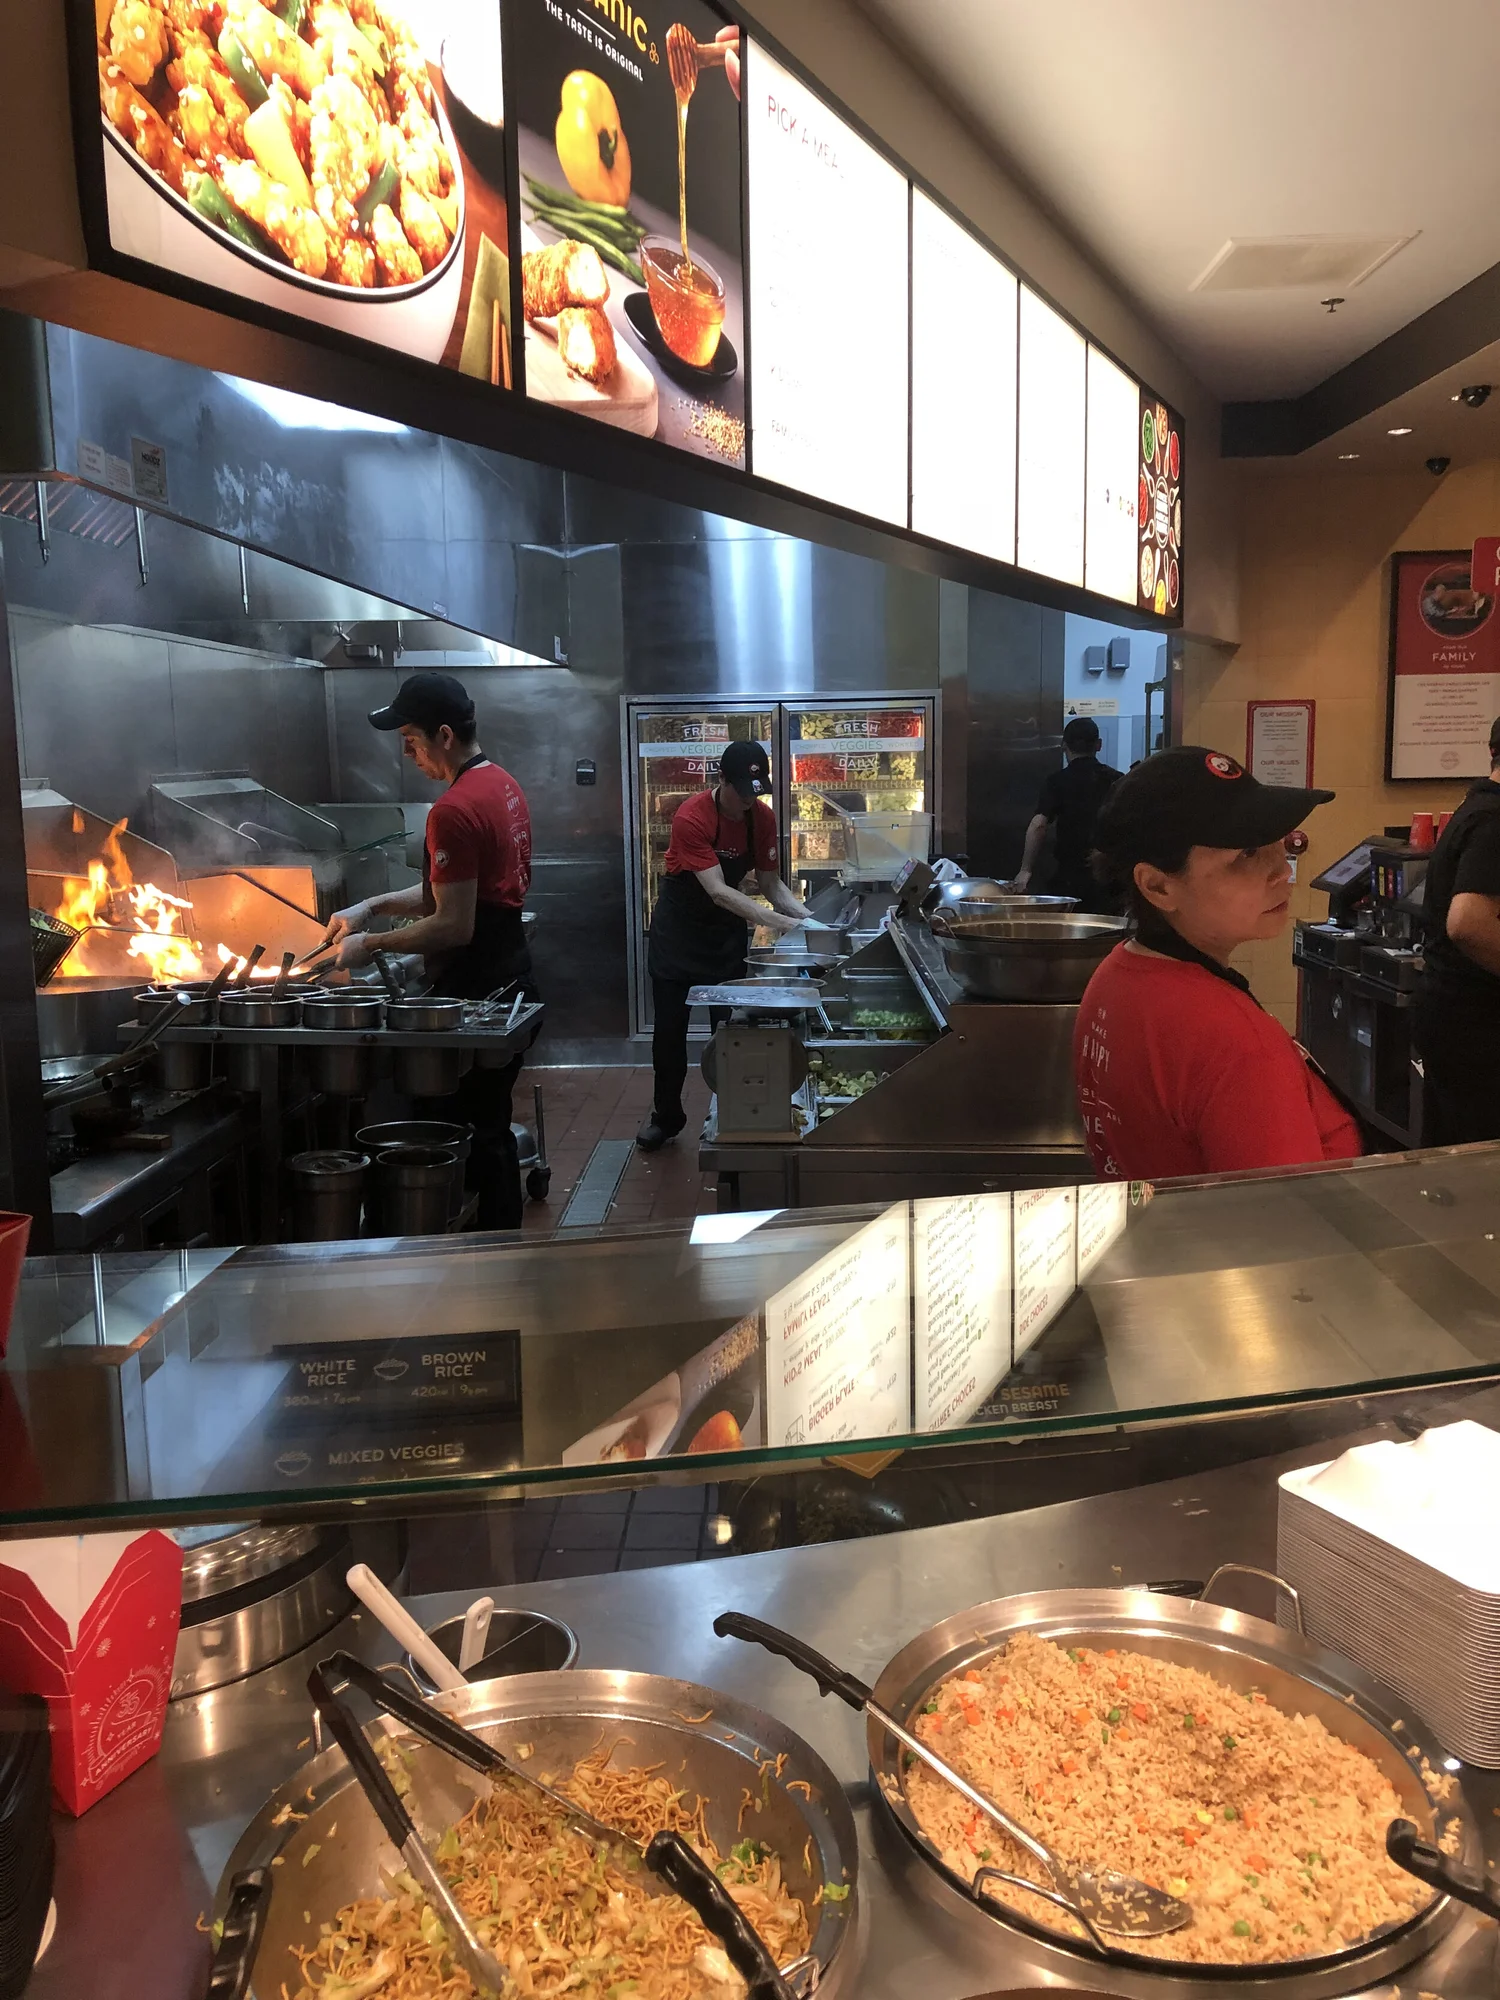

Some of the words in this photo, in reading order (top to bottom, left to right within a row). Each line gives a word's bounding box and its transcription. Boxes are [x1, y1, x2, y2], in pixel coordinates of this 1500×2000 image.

[545, 0, 563, 21] THE
[565, 13, 593, 43] TASTE
[595, 35, 603, 51] IS
[605, 43, 644, 82] ORIGINAL
[768, 95, 797, 136] PICK
[1432, 652, 1476, 662] FAMILY
[684, 725, 727, 738] FRESH
[835, 722, 879, 734] FRESH
[831, 740, 883, 751] VEGGIES
[838, 757, 875, 769] DAILY
[421, 1351, 486, 1366] BROWN
[300, 1360, 357, 1374] WHITE
[434, 1364, 473, 1378] RICE
[307, 1373, 347, 1387] RICE
[1001, 1383, 1070, 1400] SESAME
[1011, 1400, 1059, 1413] BREAST
[329, 1450, 384, 1465] MIXED
[389, 1442, 465, 1460] VEGGIES
